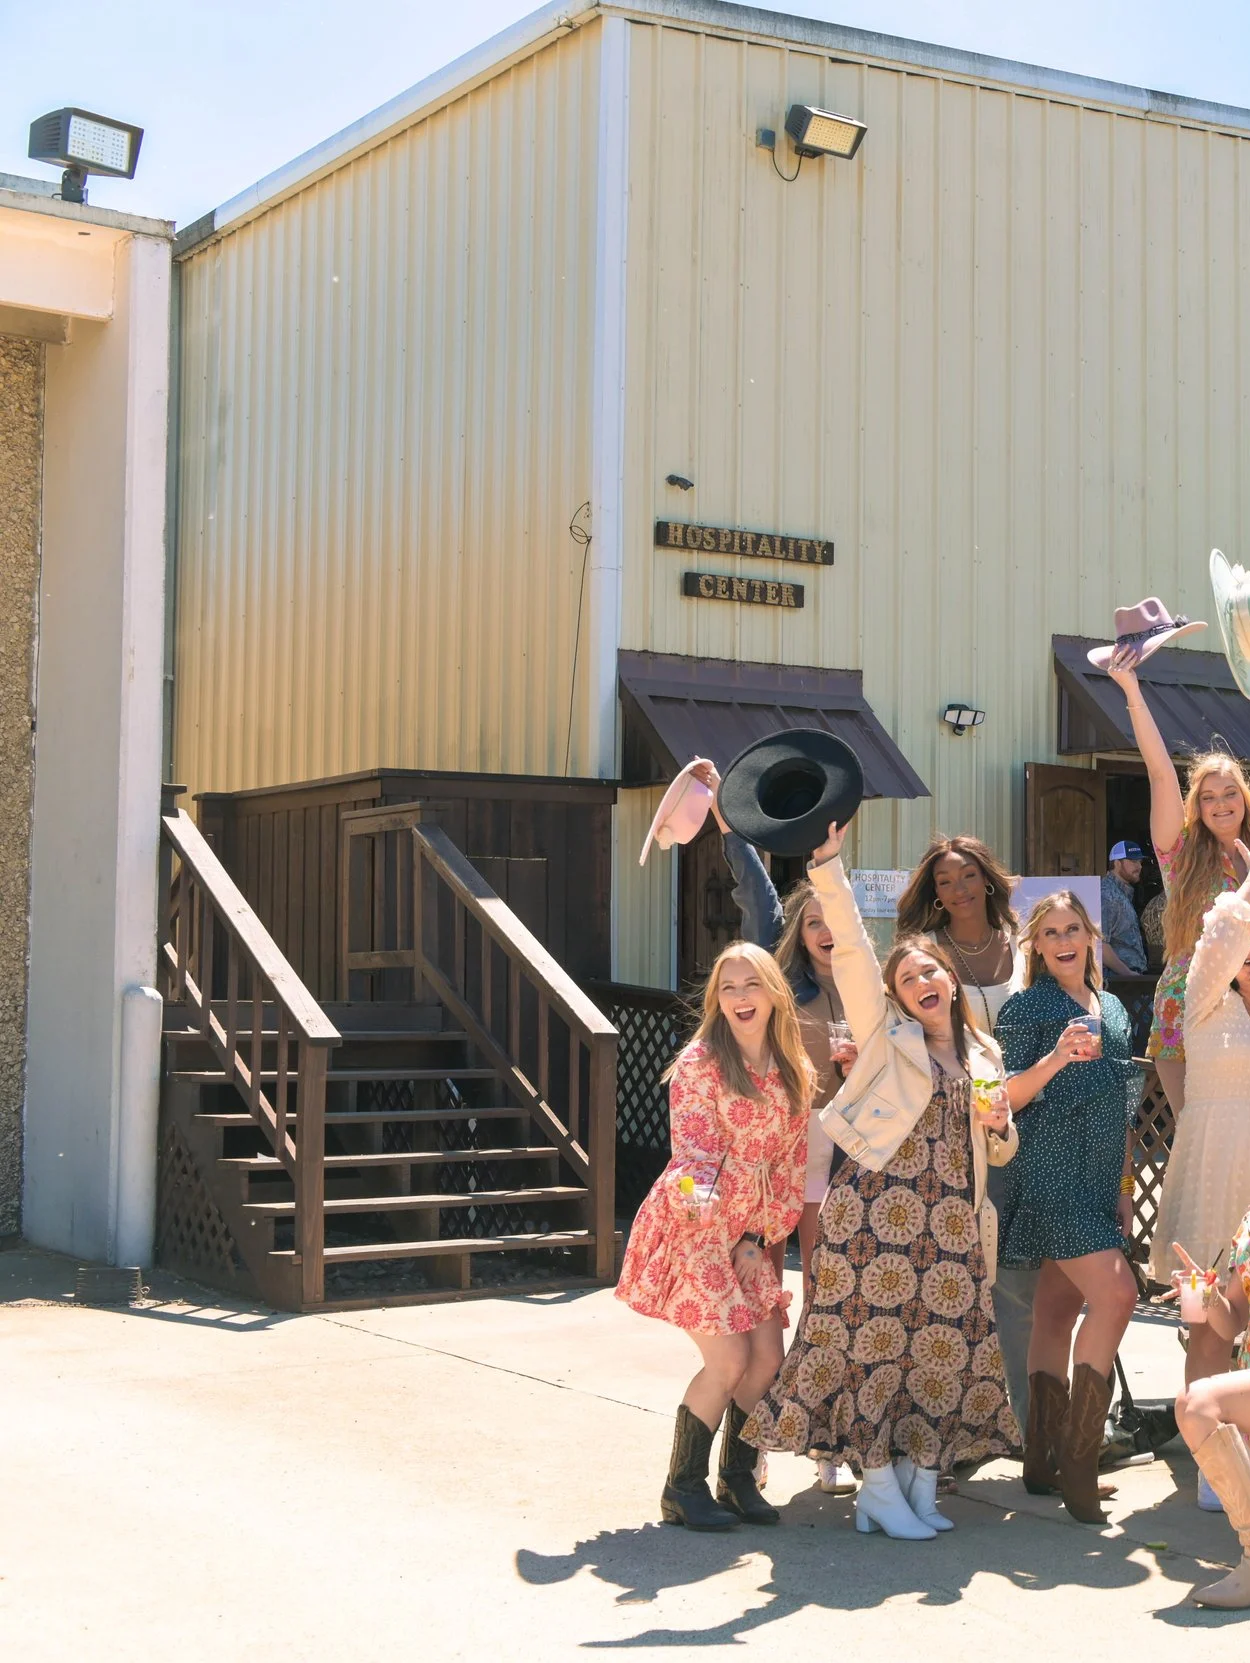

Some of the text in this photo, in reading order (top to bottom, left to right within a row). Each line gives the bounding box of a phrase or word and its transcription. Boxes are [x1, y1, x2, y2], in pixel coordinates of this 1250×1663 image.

[667, 522, 827, 563] HOSPITALITY
[698, 574, 796, 607] CENTER
[855, 873, 905, 883] HOSPITALITY
[865, 884, 896, 892] CENTER
